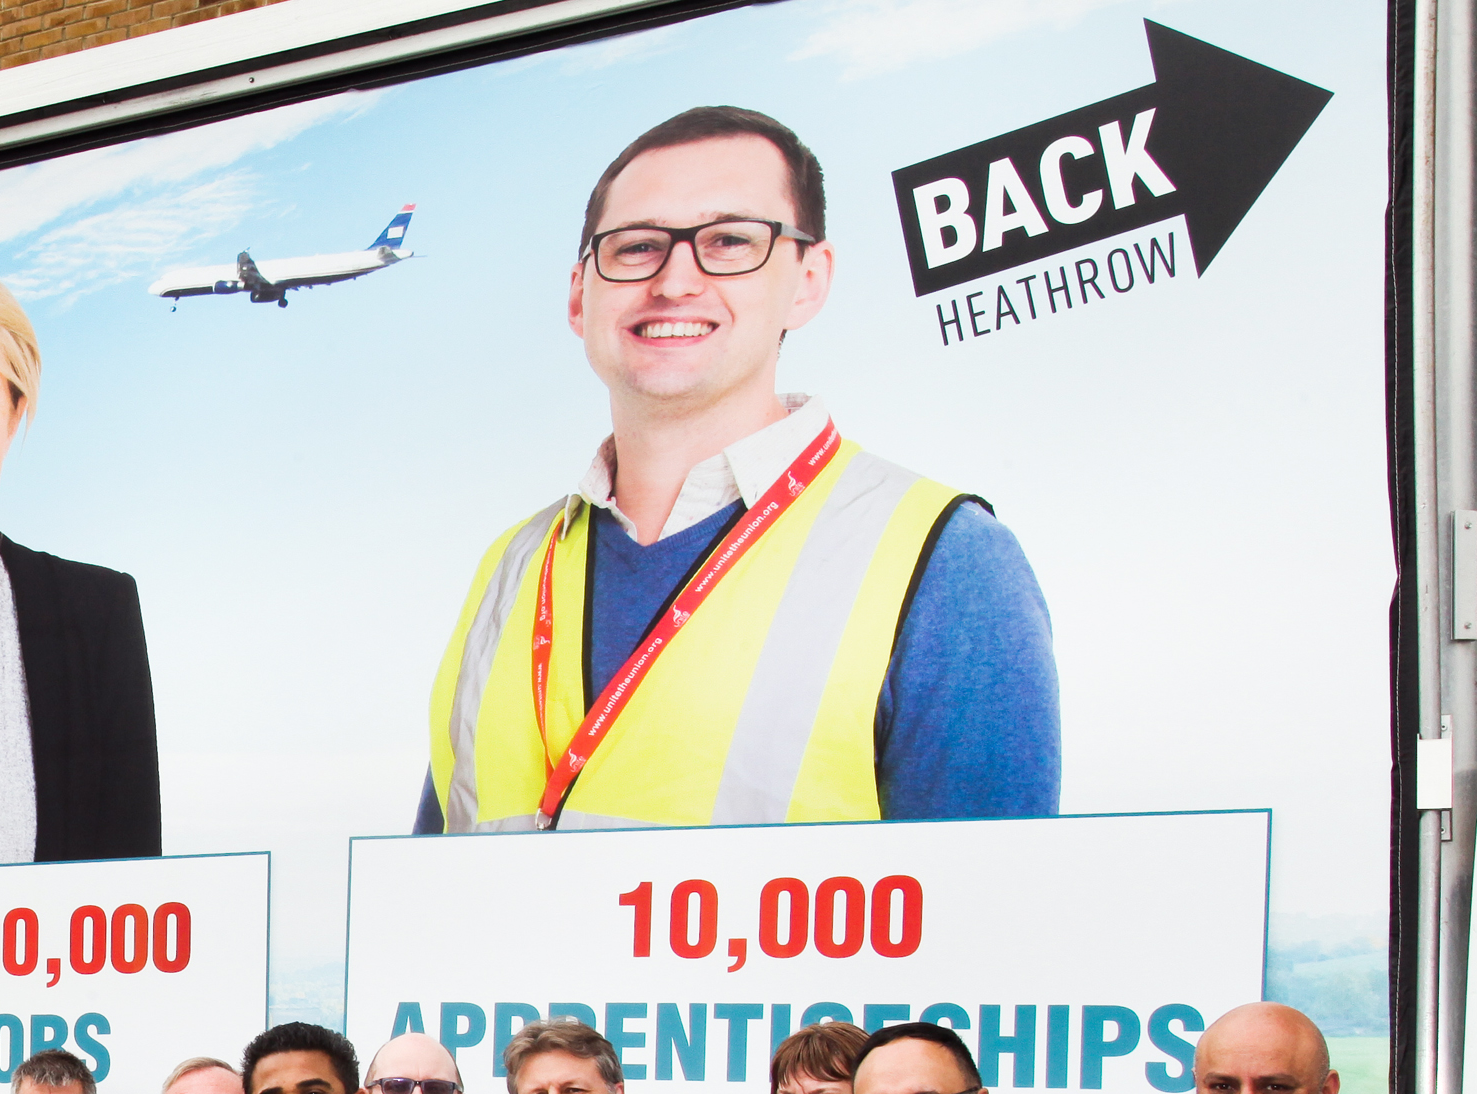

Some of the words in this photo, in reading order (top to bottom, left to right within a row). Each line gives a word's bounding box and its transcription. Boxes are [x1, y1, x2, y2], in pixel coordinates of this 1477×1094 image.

[913, 107, 1177, 269] BACK
[936, 231, 1177, 346] HEATHROW
[695, 501, 779, 593] www.unitetheunion.org
[587, 636, 663, 738] www.unitetheunion.org
[618, 874, 924, 973] 10,000
[390, 1001, 1205, 1094] PPENTIHIPS
